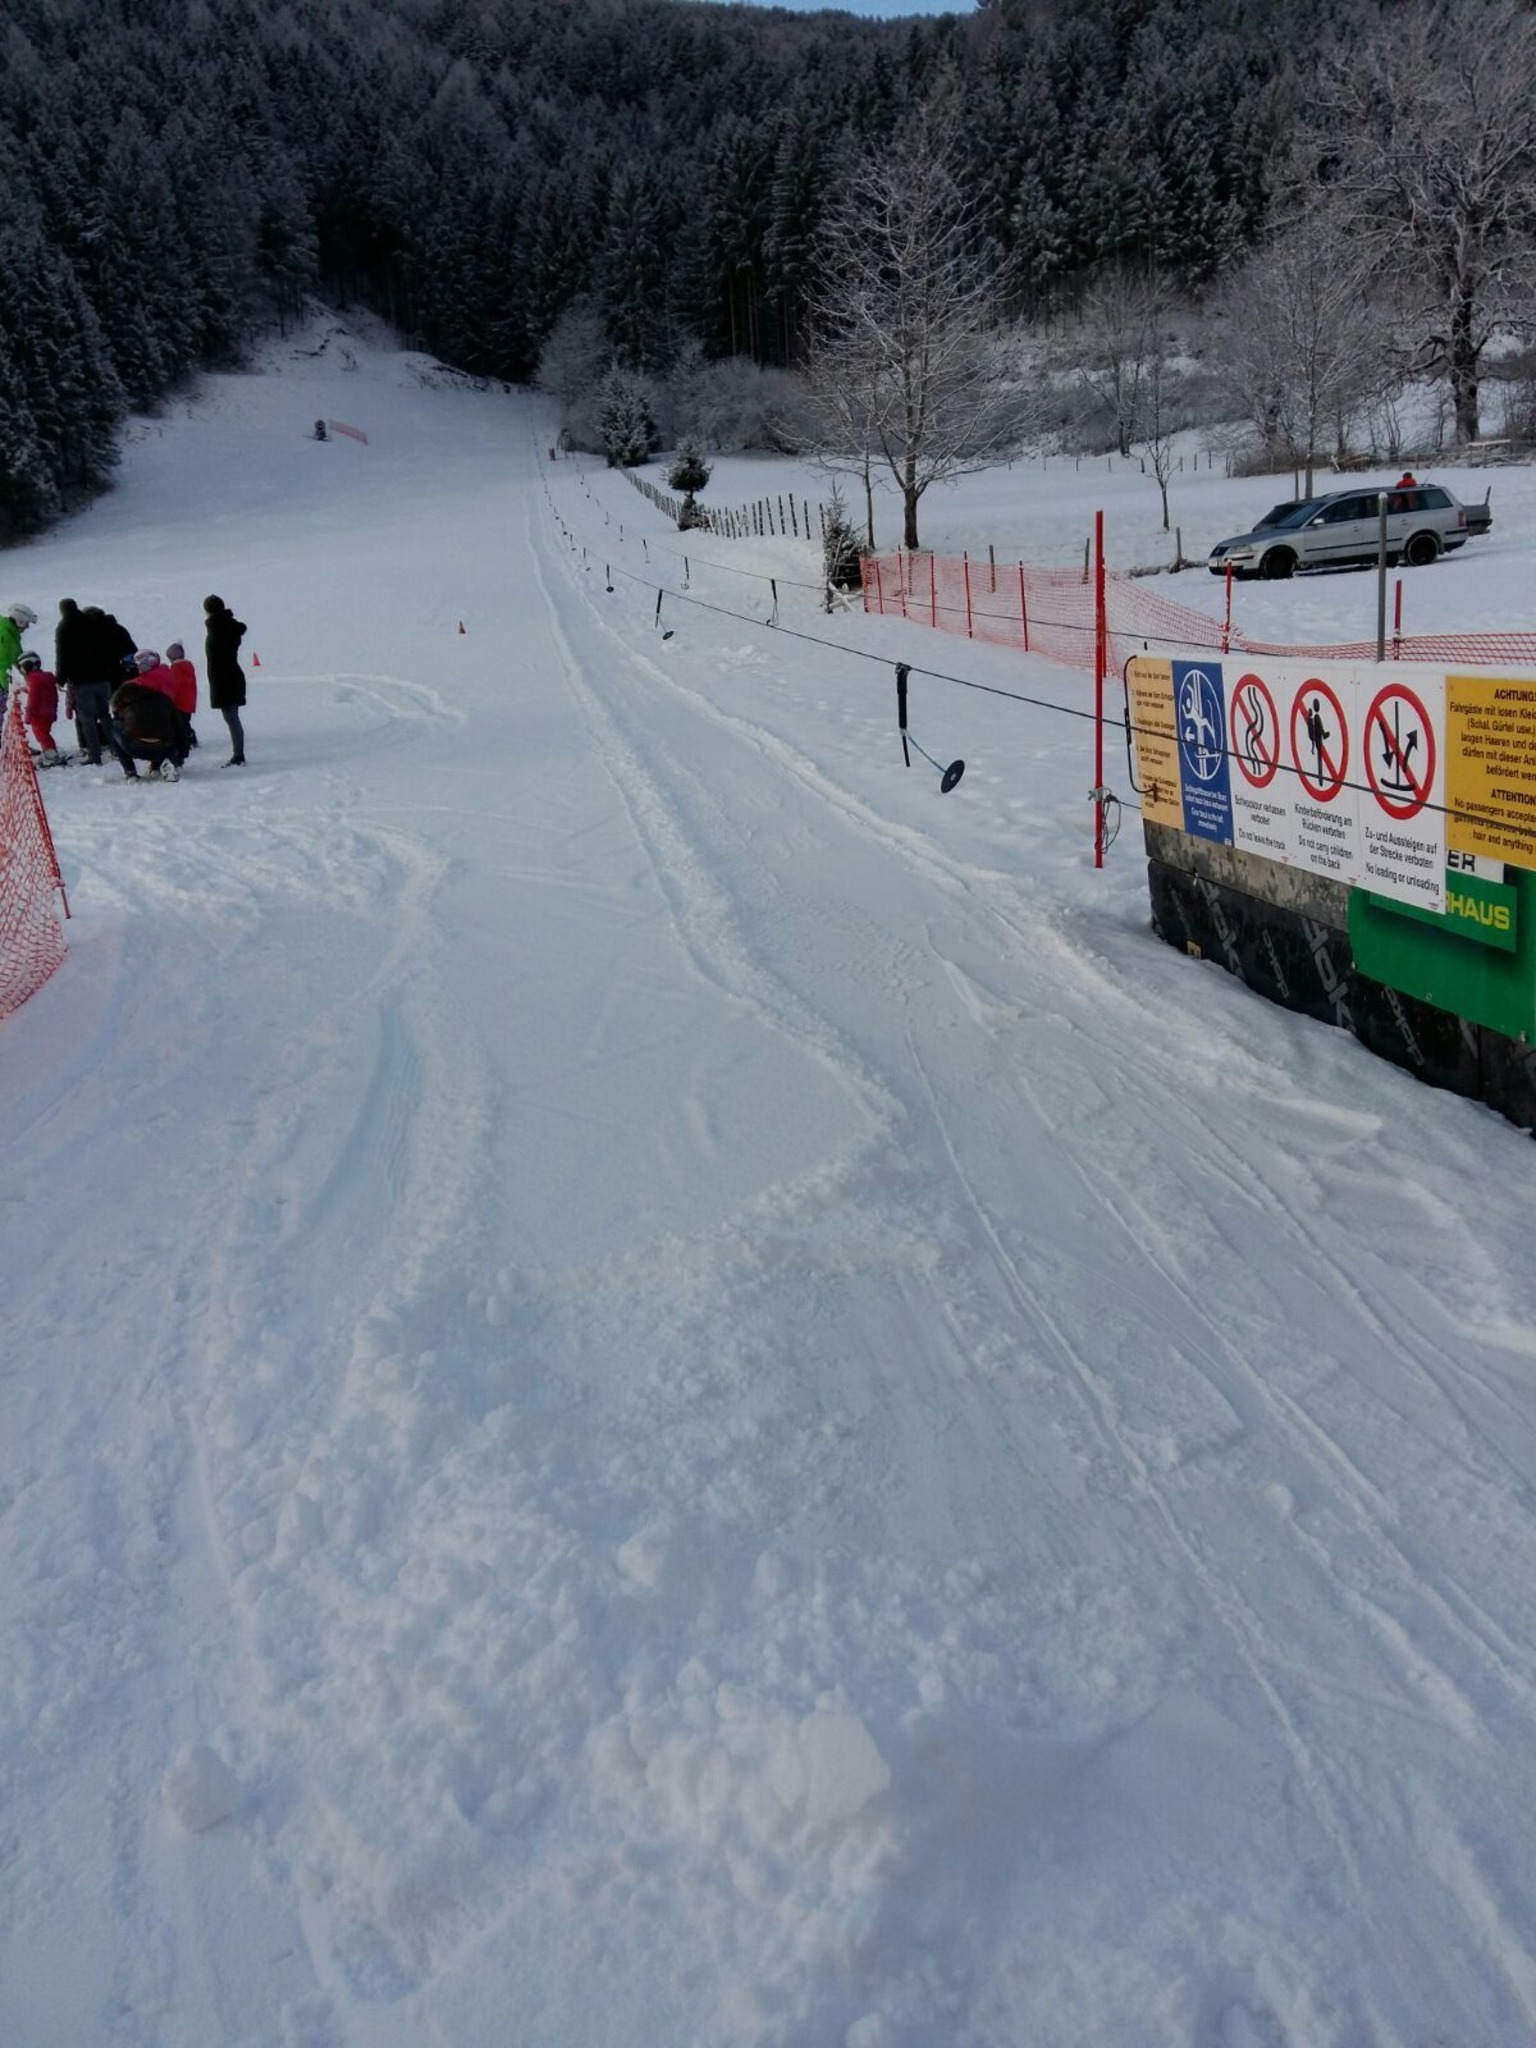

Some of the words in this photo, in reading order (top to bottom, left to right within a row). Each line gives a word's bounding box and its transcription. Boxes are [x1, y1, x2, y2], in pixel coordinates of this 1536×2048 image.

[1485, 704, 1496, 716] mit
[1512, 739, 1527, 749] und
[1388, 832, 1425, 853] Aussteigen
[1426, 842, 1438, 855] auf
[1380, 845, 1403, 862] Strecke
[1404, 854, 1434, 869] verboten
[1366, 861, 1374, 874] No
[1375, 864, 1397, 884] loading
[1398, 873, 1405, 883] or
[1406, 874, 1440, 896] unloading
[1301, 917, 1357, 1034] dok
